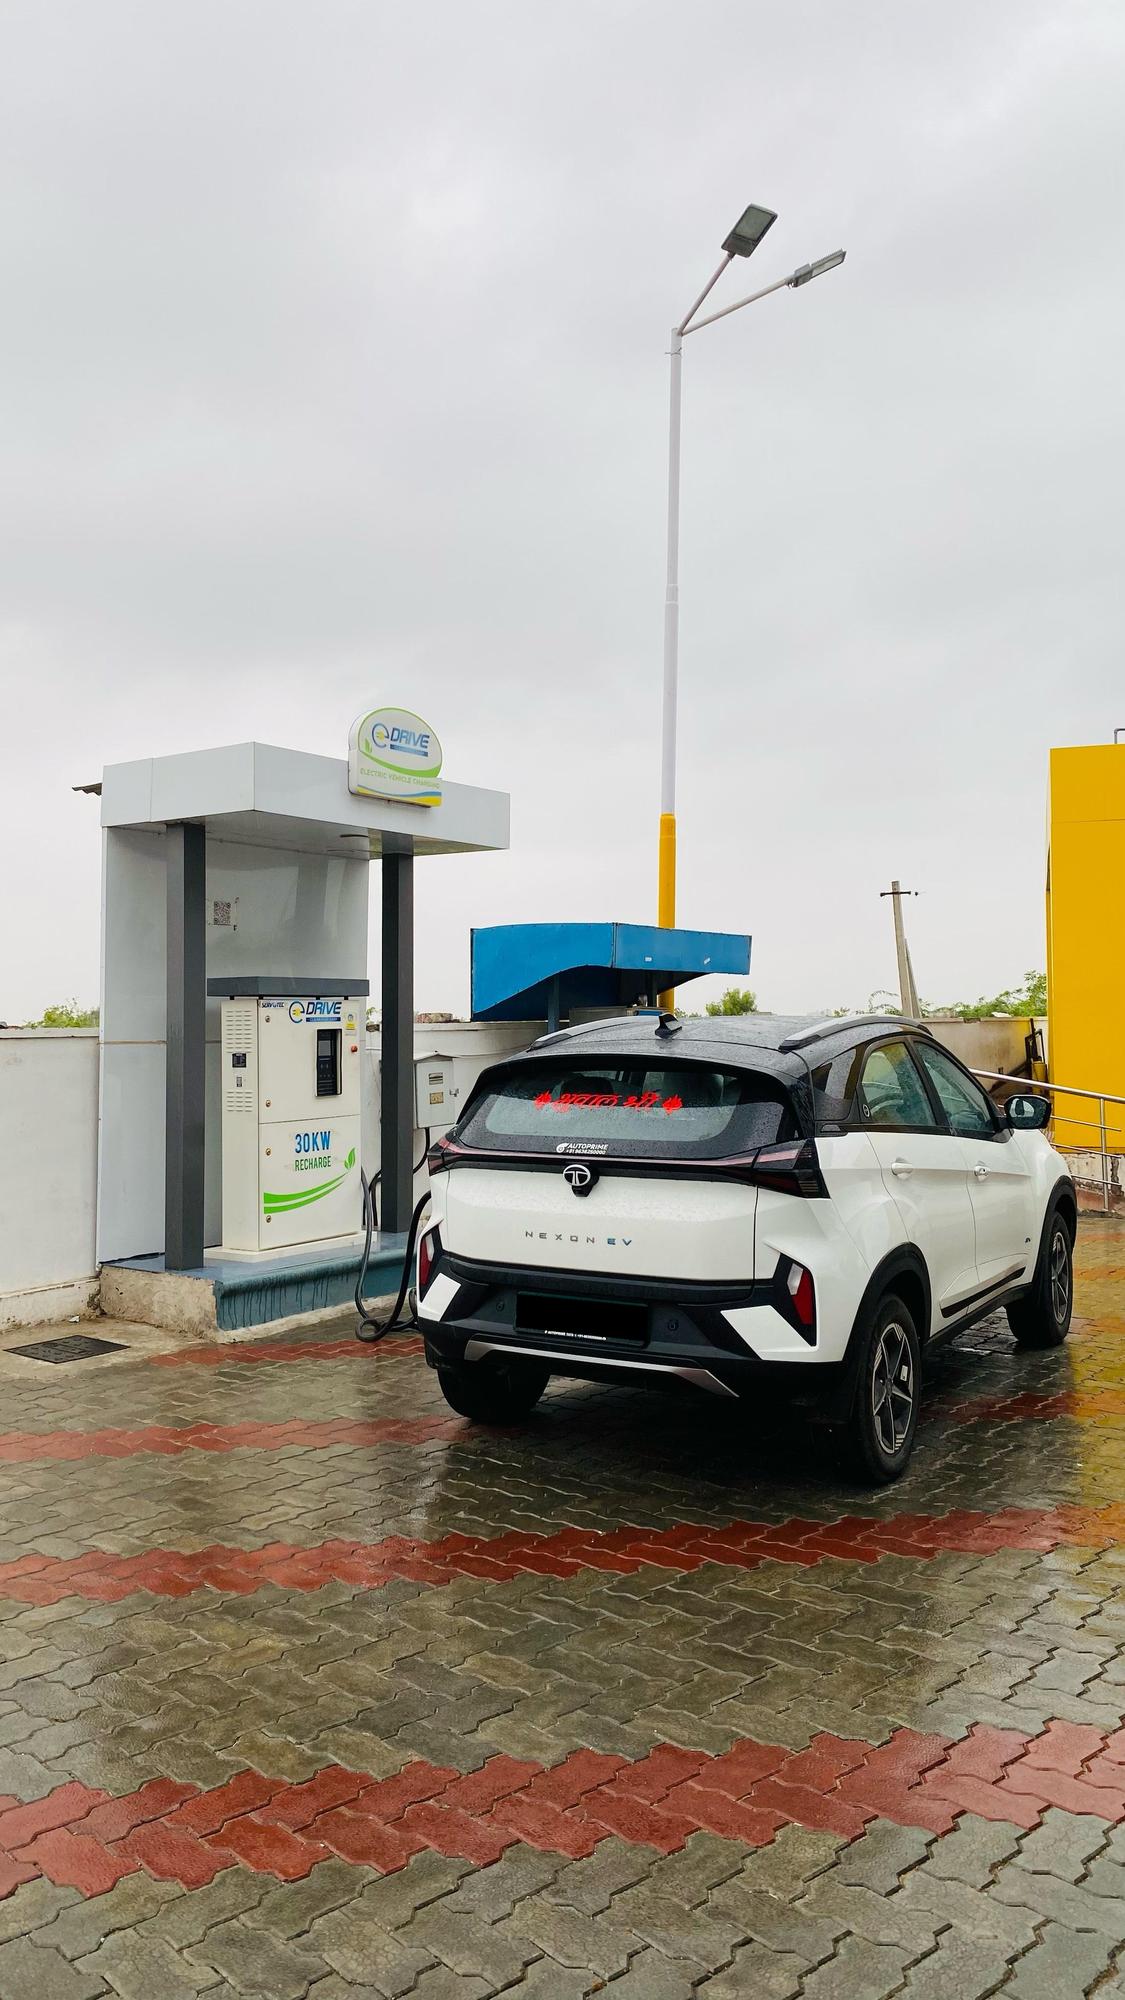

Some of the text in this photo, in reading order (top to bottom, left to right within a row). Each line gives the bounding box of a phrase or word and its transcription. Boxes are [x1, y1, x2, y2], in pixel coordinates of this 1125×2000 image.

[306, 1002, 342, 1015] DRIVE
[294, 1156, 332, 1172] RECHARGE
[525, 1230, 633, 1247] NEXON EV
